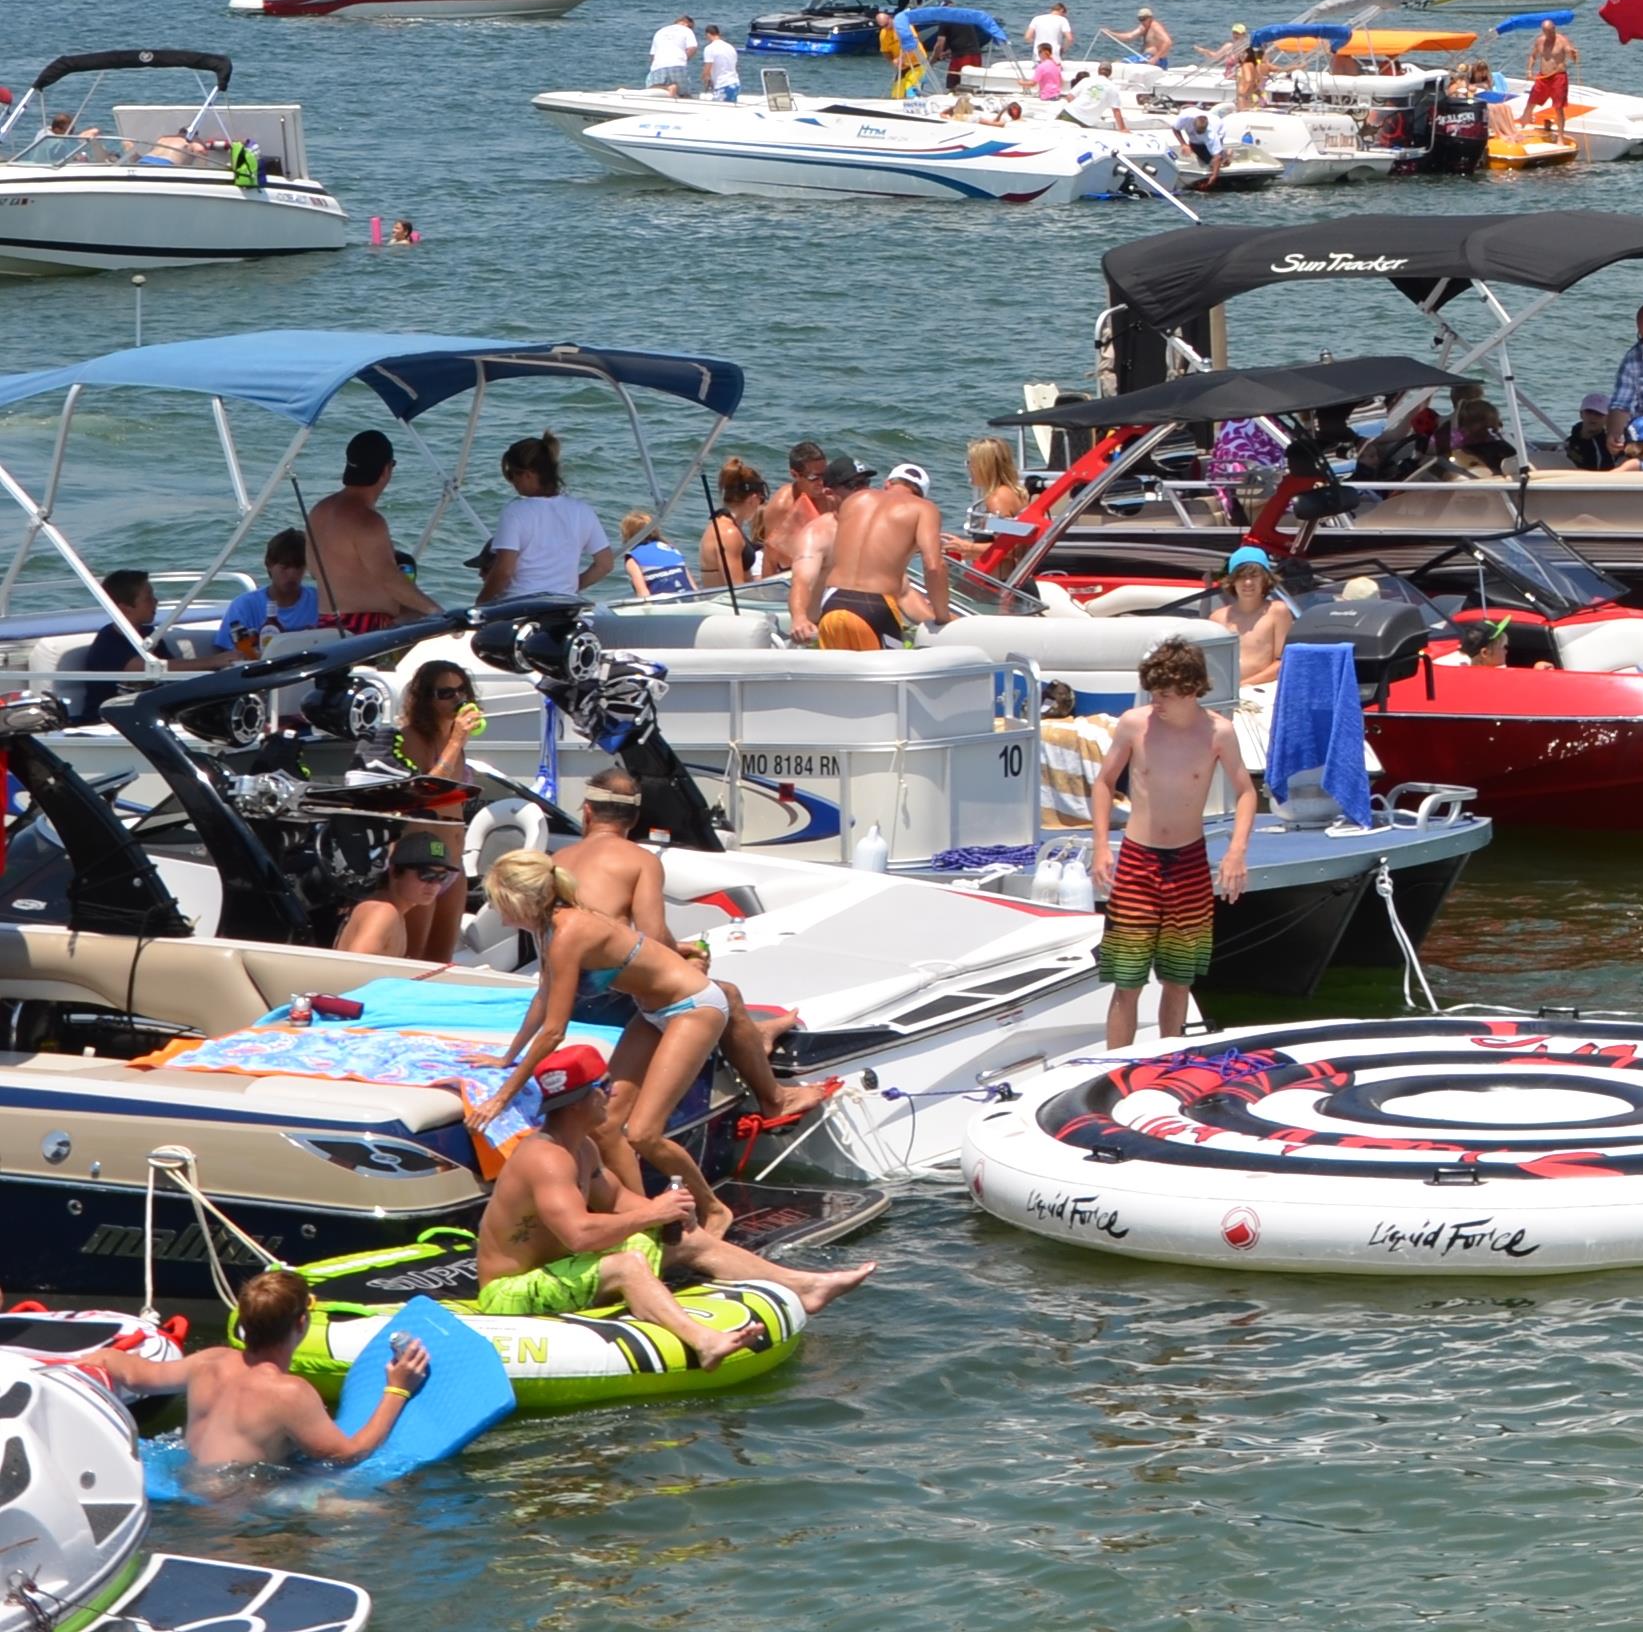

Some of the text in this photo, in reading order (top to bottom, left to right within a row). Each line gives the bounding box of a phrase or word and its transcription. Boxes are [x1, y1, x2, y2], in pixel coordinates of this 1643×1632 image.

[1270, 252, 1409, 274] Sun Tracker
[742, 754, 768, 776] MO
[773, 754, 814, 776] 8184
[998, 744, 1024, 778] 10
[1026, 1188, 1130, 1240] Liquid Force
[1367, 1216, 1541, 1257] Liquid Force
